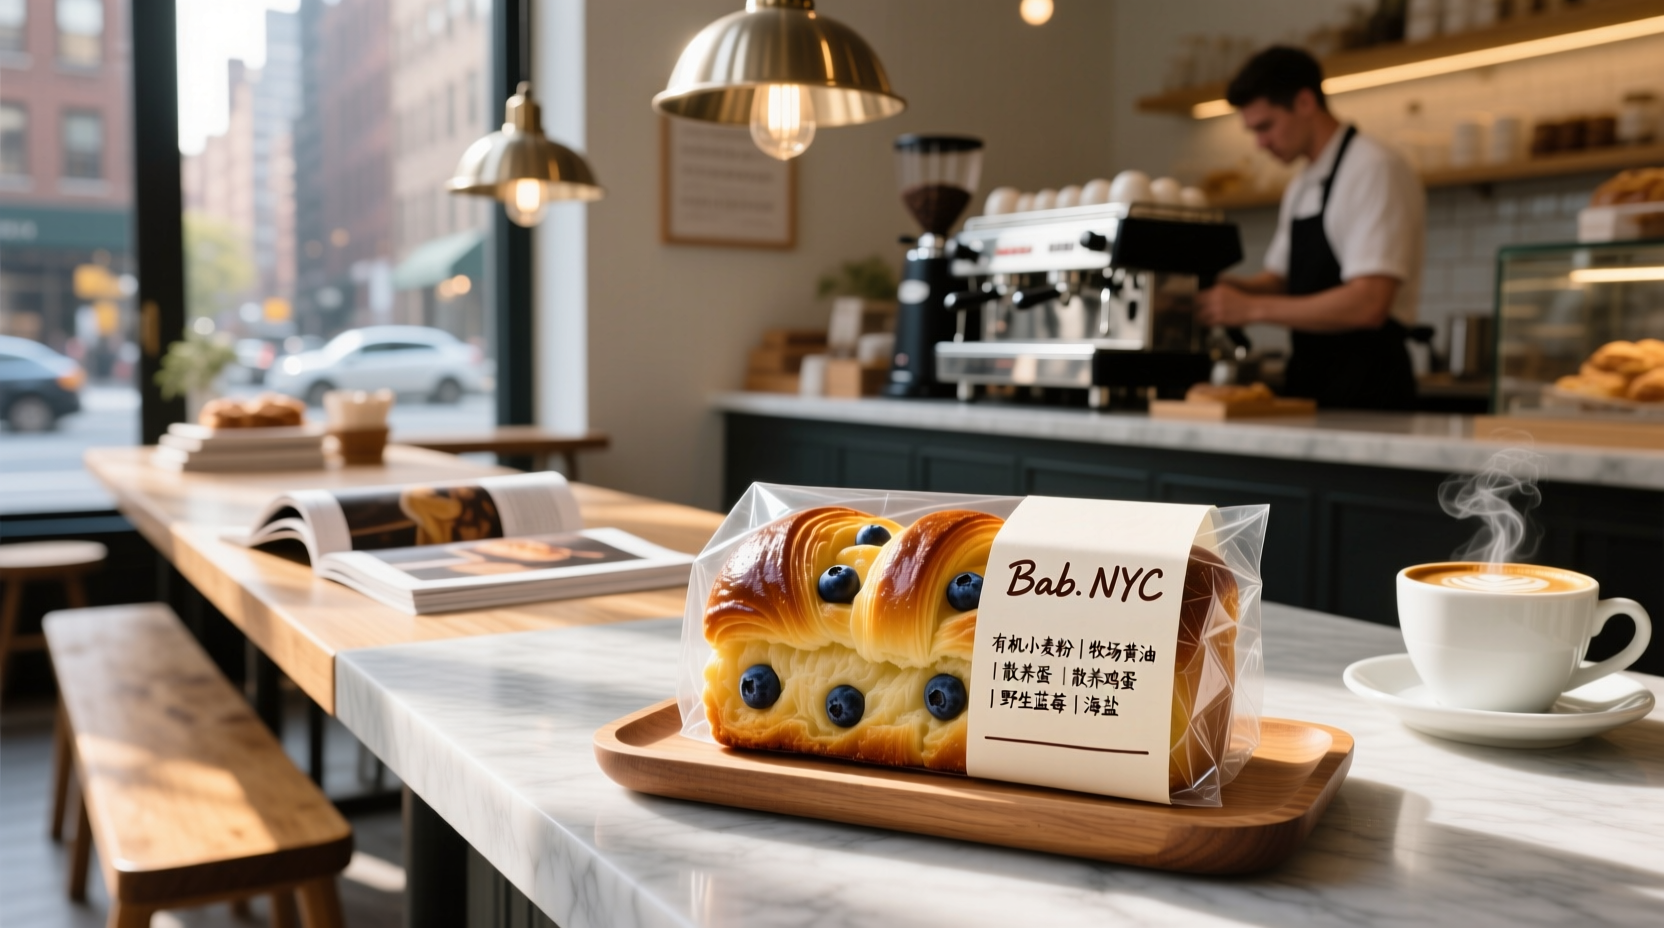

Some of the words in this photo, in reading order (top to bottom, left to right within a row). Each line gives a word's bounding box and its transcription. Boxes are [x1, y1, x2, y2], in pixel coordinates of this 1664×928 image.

[1006, 559, 1082, 597] Bab.
[1089, 565, 1164, 602] NYC
[992, 632, 1075, 658] 有机小麦粉
[1088, 640, 1157, 663] 牧场黄油
[1072, 667, 1138, 690] 散养鸡蛋
[1000, 689, 1067, 714] 野生蓝莓
[1084, 695, 1119, 717] 海盐
